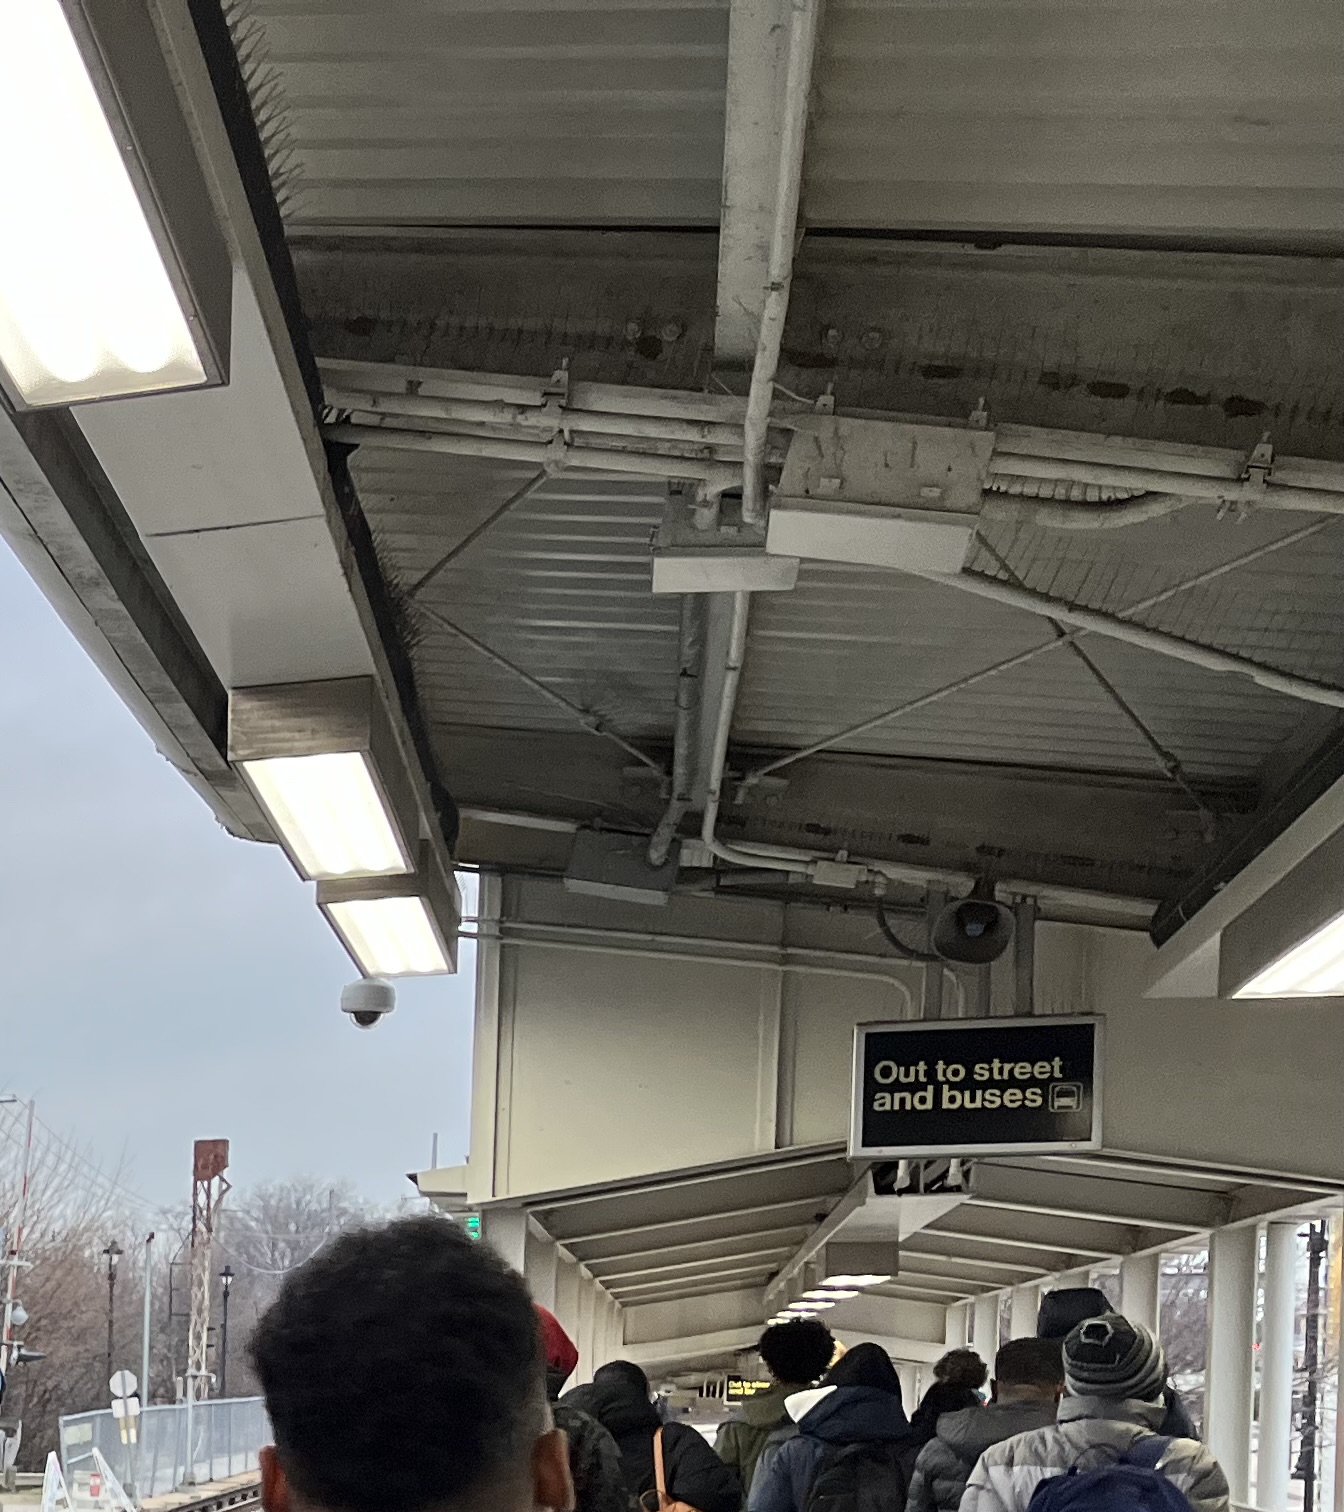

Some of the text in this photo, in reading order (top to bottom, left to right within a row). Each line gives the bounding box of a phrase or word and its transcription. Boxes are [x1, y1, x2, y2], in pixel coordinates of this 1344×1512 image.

[874, 1056, 1063, 1084] Out to street
[873, 1084, 1043, 1111] and buses
